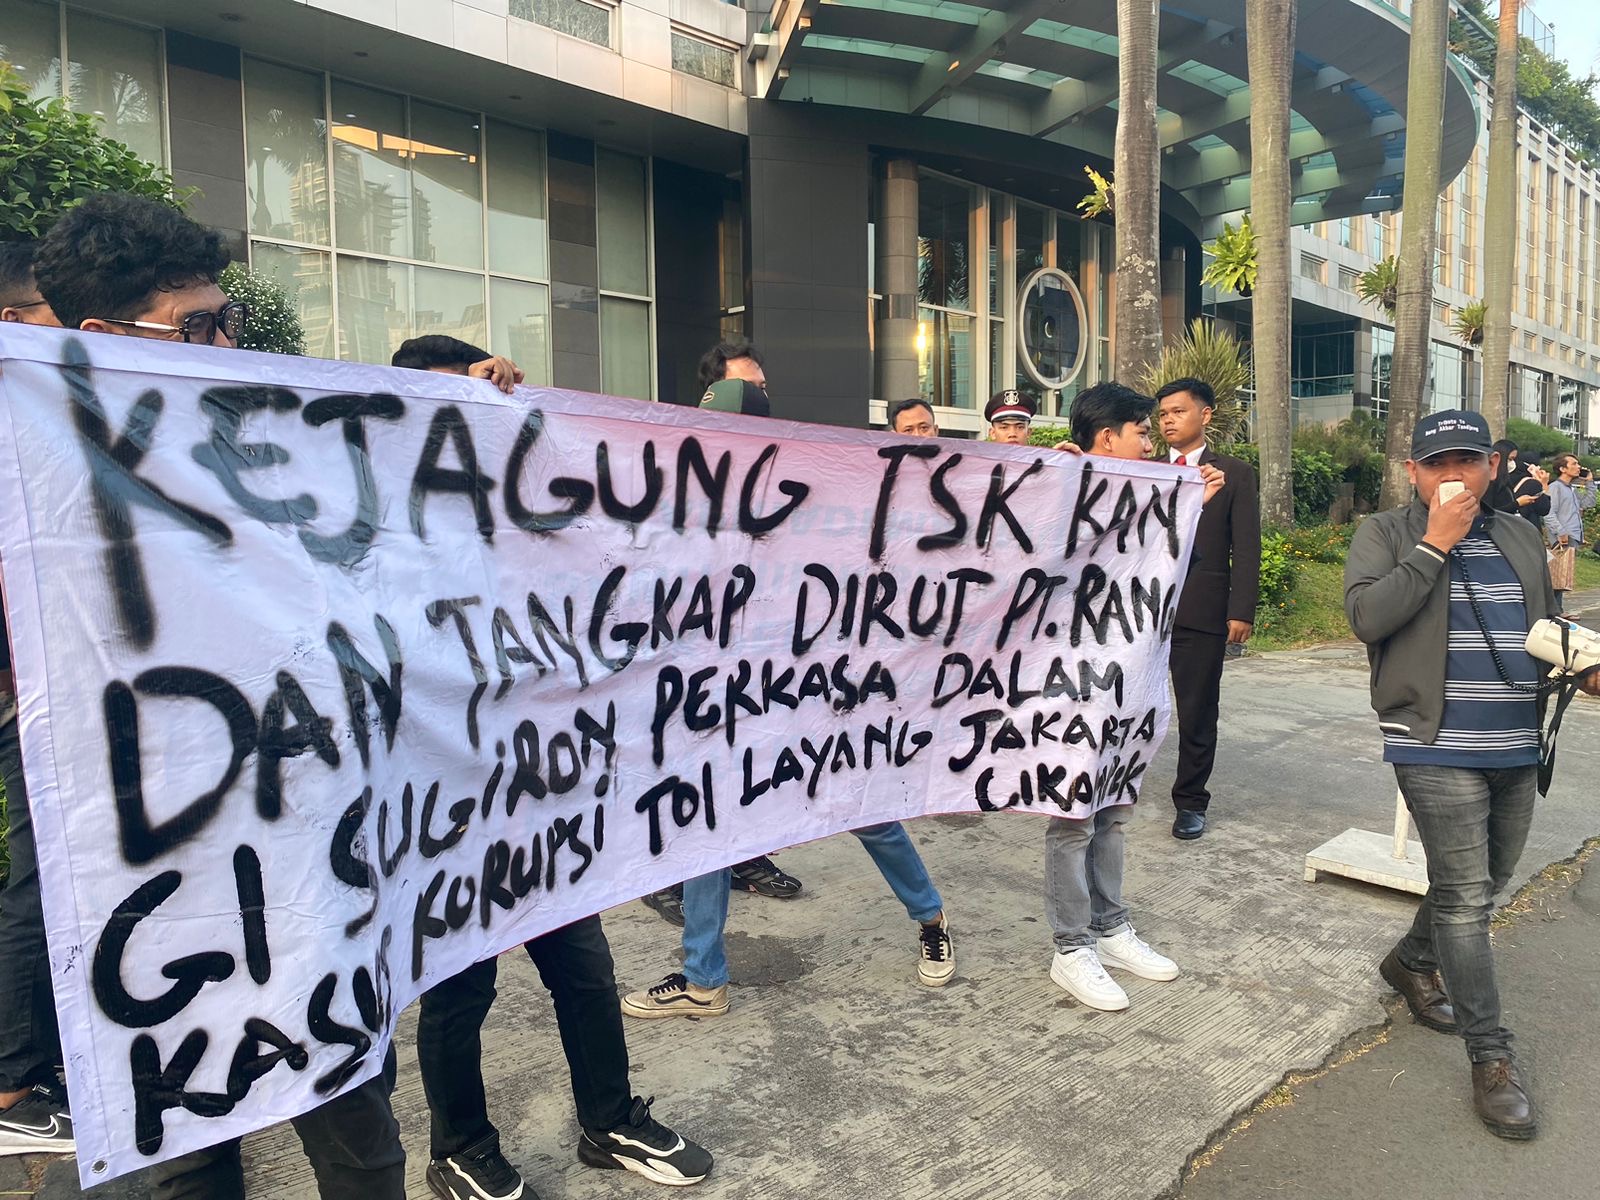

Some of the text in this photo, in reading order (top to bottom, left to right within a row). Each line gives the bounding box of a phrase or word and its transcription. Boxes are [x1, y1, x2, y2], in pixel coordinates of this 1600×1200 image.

[867, 443, 1045, 562] TSK
[1064, 460, 1183, 560] KAN
[104, 613, 404, 866] DAN
[426, 563, 757, 752] TANGKAP
[792, 562, 995, 657] DIRUT
[740, 715, 933, 807] LAYANG
[948, 707, 1157, 773] JAKARTA
[93, 844, 272, 1029] GI
[652, 654, 897, 766] PERKASA
[931, 649, 1124, 709] DALAM
